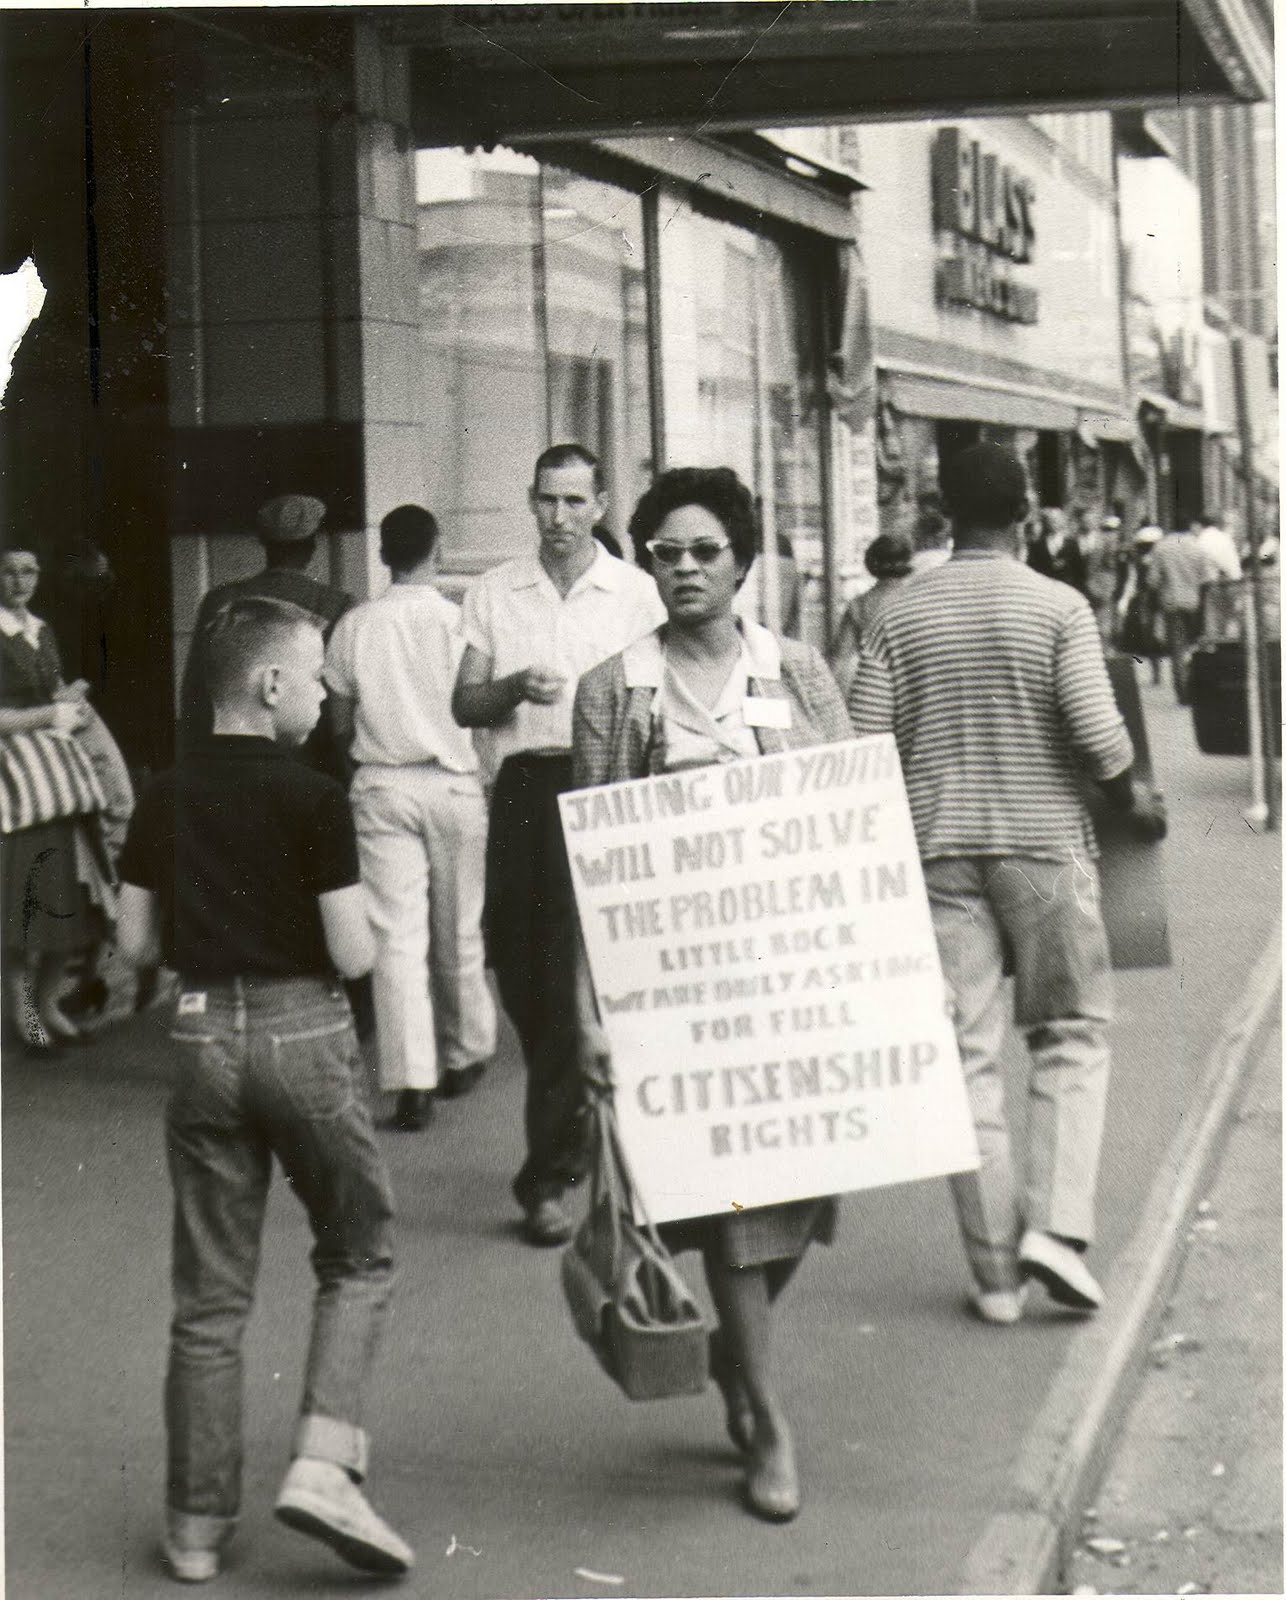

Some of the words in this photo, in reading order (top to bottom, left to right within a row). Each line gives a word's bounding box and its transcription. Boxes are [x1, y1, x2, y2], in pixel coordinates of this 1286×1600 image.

[567, 774, 712, 832] JAILING
[723, 760, 786, 805] OUR
[794, 741, 896, 795] YOUTH
[574, 843, 656, 888] WILL
[673, 828, 745, 874] NOT
[759, 803, 880, 859] SOLVE
[598, 899, 664, 943] THE
[670, 870, 846, 932] PROBLEM
[860, 861, 909, 904] IN
[658, 937, 756, 971] LITTLE
[770, 922, 857, 956] ROCK
[652, 982, 705, 1010] ARE
[713, 972, 796, 1002] ONLY
[802, 954, 934, 990] ASKING
[690, 1014, 754, 1043] FOR
[769, 1001, 857, 1035] FULL
[710, 1106, 870, 1157] RIGHTS
